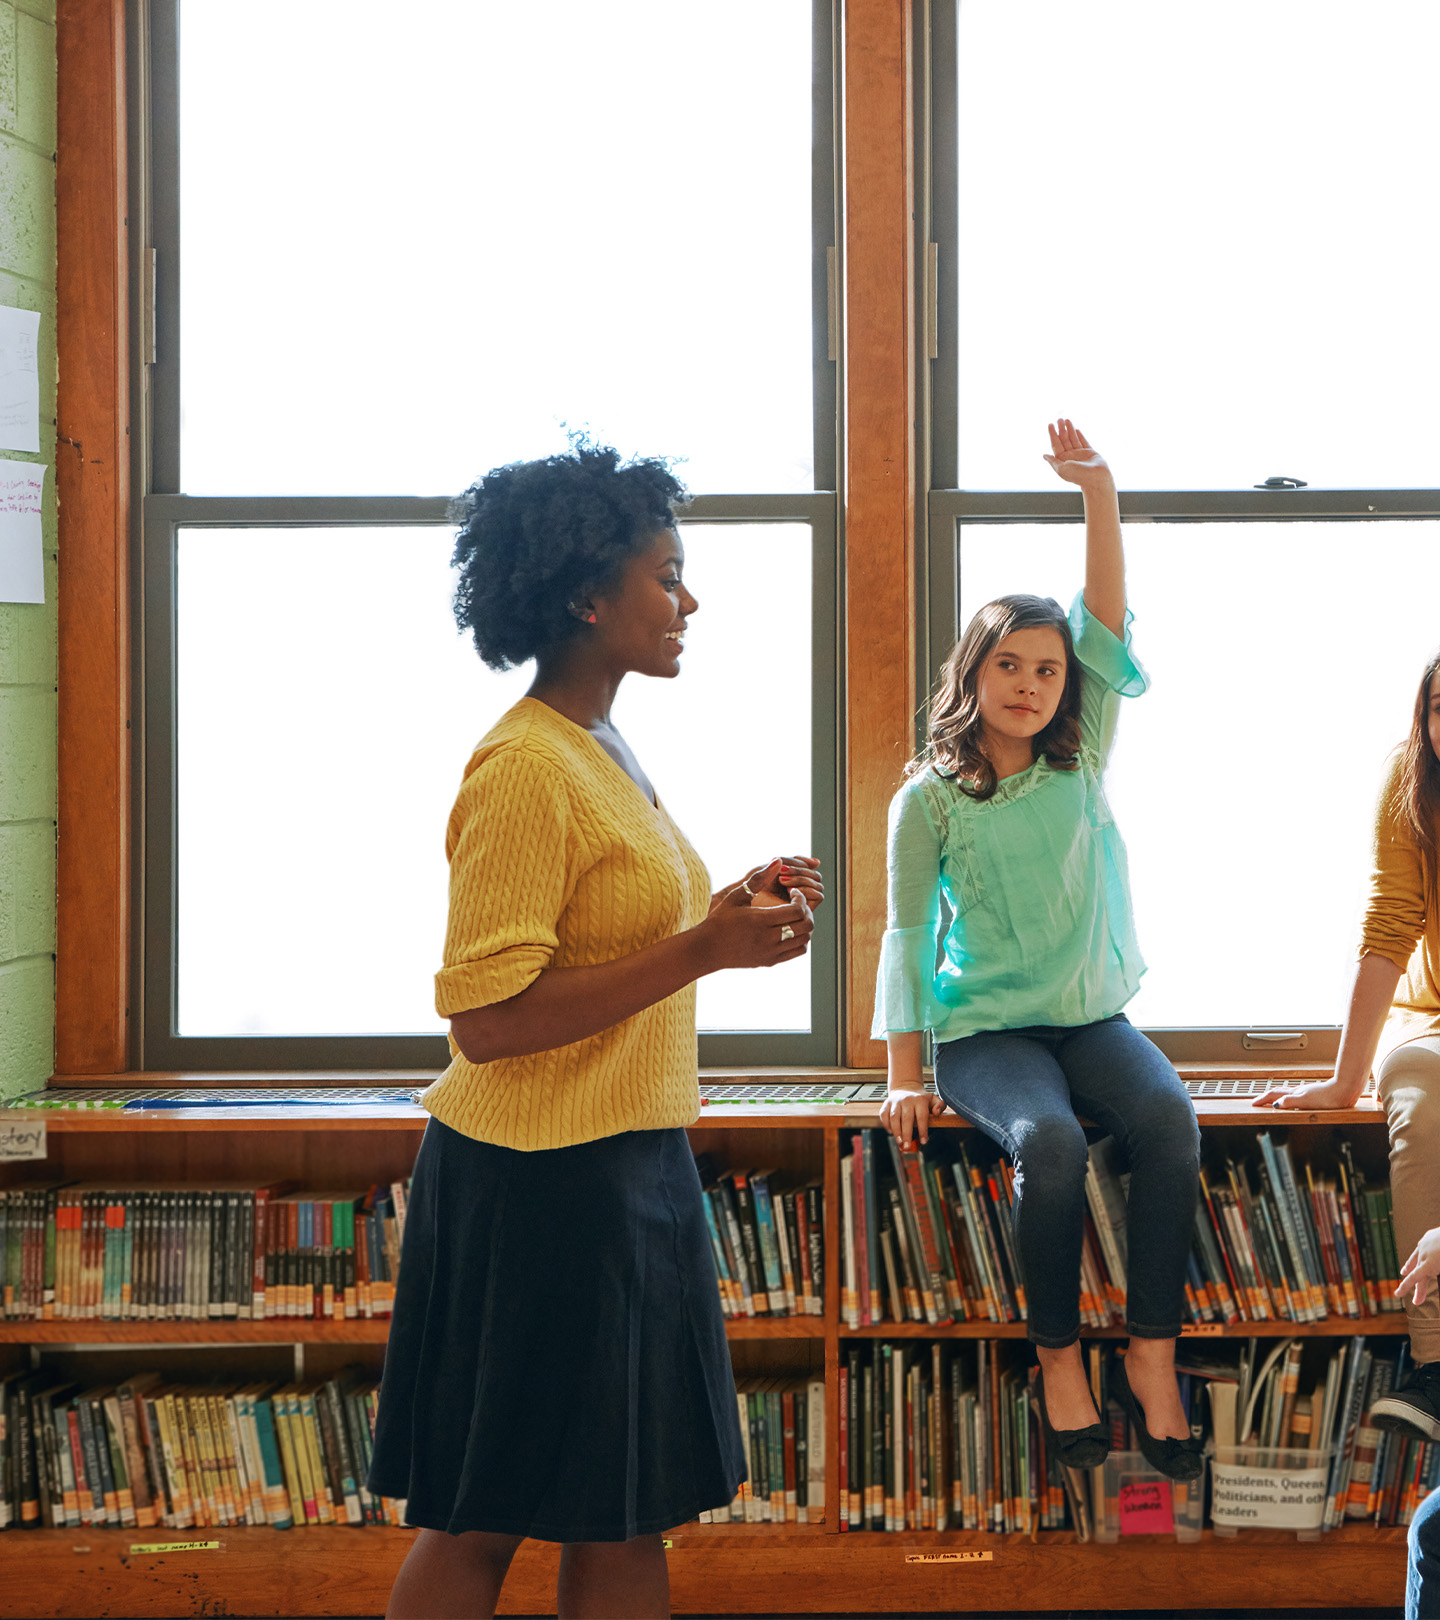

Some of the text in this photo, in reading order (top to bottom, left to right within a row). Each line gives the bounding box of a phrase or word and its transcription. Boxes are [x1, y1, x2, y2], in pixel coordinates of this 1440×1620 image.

[0, 1126, 42, 1149] stery
[1215, 1474, 1278, 1488] Presidents,
[1123, 1484, 1160, 1500] Strong
[1214, 1490, 1277, 1504] Politicians,
[1280, 1494, 1303, 1504] and
[1214, 1504, 1258, 1517] Leaders
